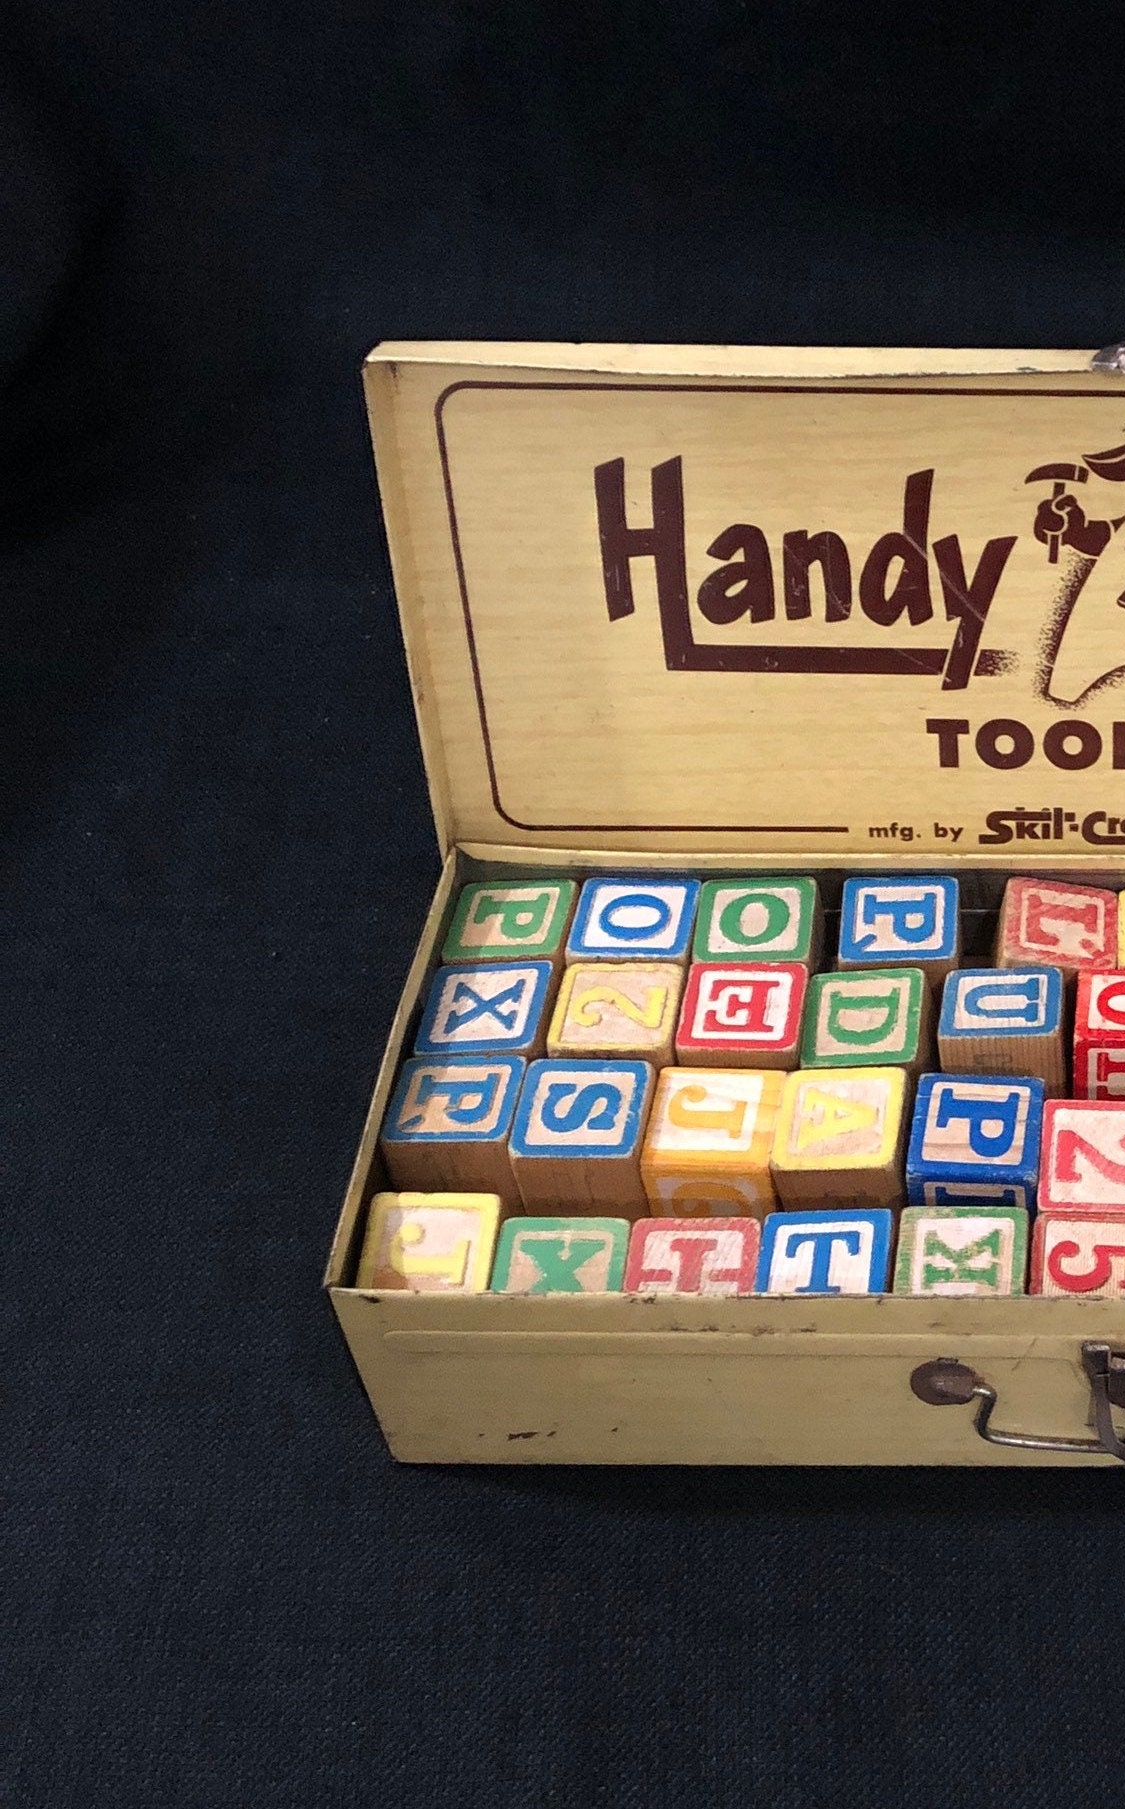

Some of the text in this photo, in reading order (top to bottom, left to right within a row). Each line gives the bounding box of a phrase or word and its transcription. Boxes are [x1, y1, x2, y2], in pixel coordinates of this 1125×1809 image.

[593, 454, 1019, 690] Handy
[868, 823, 921, 842] mfg.
[934, 822, 963, 842] by
[473, 892, 551, 939] P
[719, 893, 790, 945] O
[444, 979, 526, 1033] X
[702, 979, 780, 1033] E
[827, 987, 900, 1046] D
[963, 977, 1040, 1023] U
[541, 1082, 622, 1133] S
[797, 1086, 877, 1150] A
[936, 1088, 1020, 1158] P
[785, 1231, 861, 1293] T
